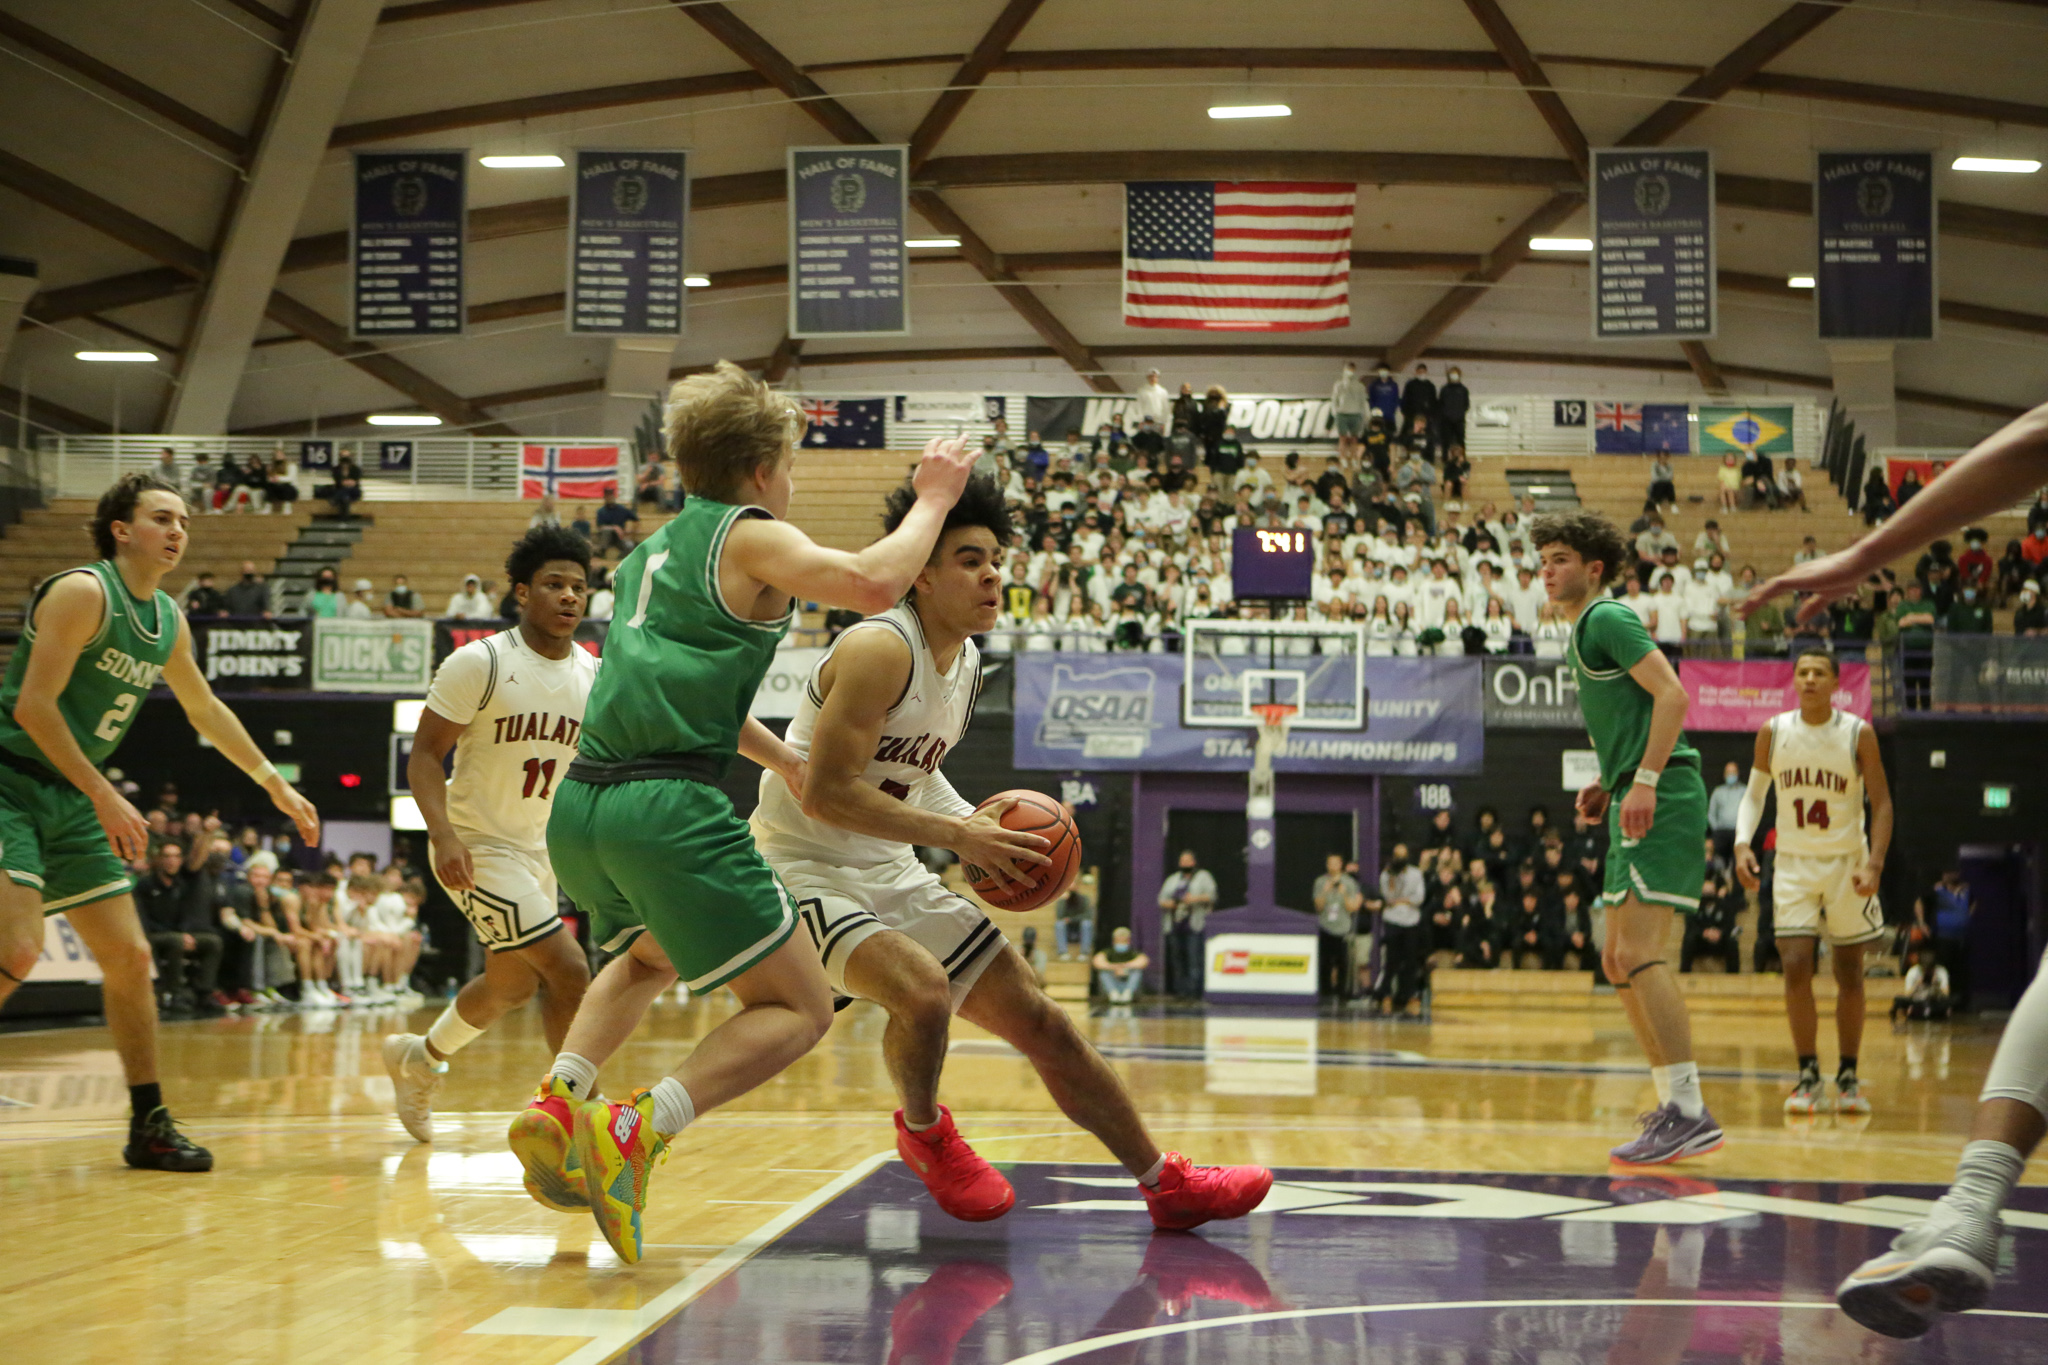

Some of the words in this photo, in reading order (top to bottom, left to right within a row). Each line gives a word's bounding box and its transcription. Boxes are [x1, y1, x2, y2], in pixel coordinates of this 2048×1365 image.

[582, 161, 617, 180] HALL
[620, 159, 639, 170] OF
[642, 160, 679, 180] FAME
[798, 160, 834, 180] HALL
[836, 157, 857, 170] OF
[859, 158, 897, 178] FAME
[1601, 161, 1637, 181] HALL
[1640, 158, 1660, 171] OF
[1663, 160, 1702, 180] FAME
[1824, 162, 1859, 182] HALL
[1863, 160, 1882, 172] OF
[1887, 160, 1925, 181] FAME
[1561, 402, 1582, 425] 19
[307, 445, 328, 464] 16
[387, 445, 408, 464] 17
[1256, 530, 1304, 553] 7:41
[626, 548, 670, 630] 1
[207, 630, 303, 654] JIMMY
[322, 635, 421, 672] DICK'S
[206, 655, 304, 681] JOHN'S
[93, 692, 138, 742] 2
[1051, 696, 1147, 721] OSAA
[521, 757, 557, 800] 11
[1779, 766, 1848, 796] TUALATIN
[1793, 798, 1830, 830] 14
